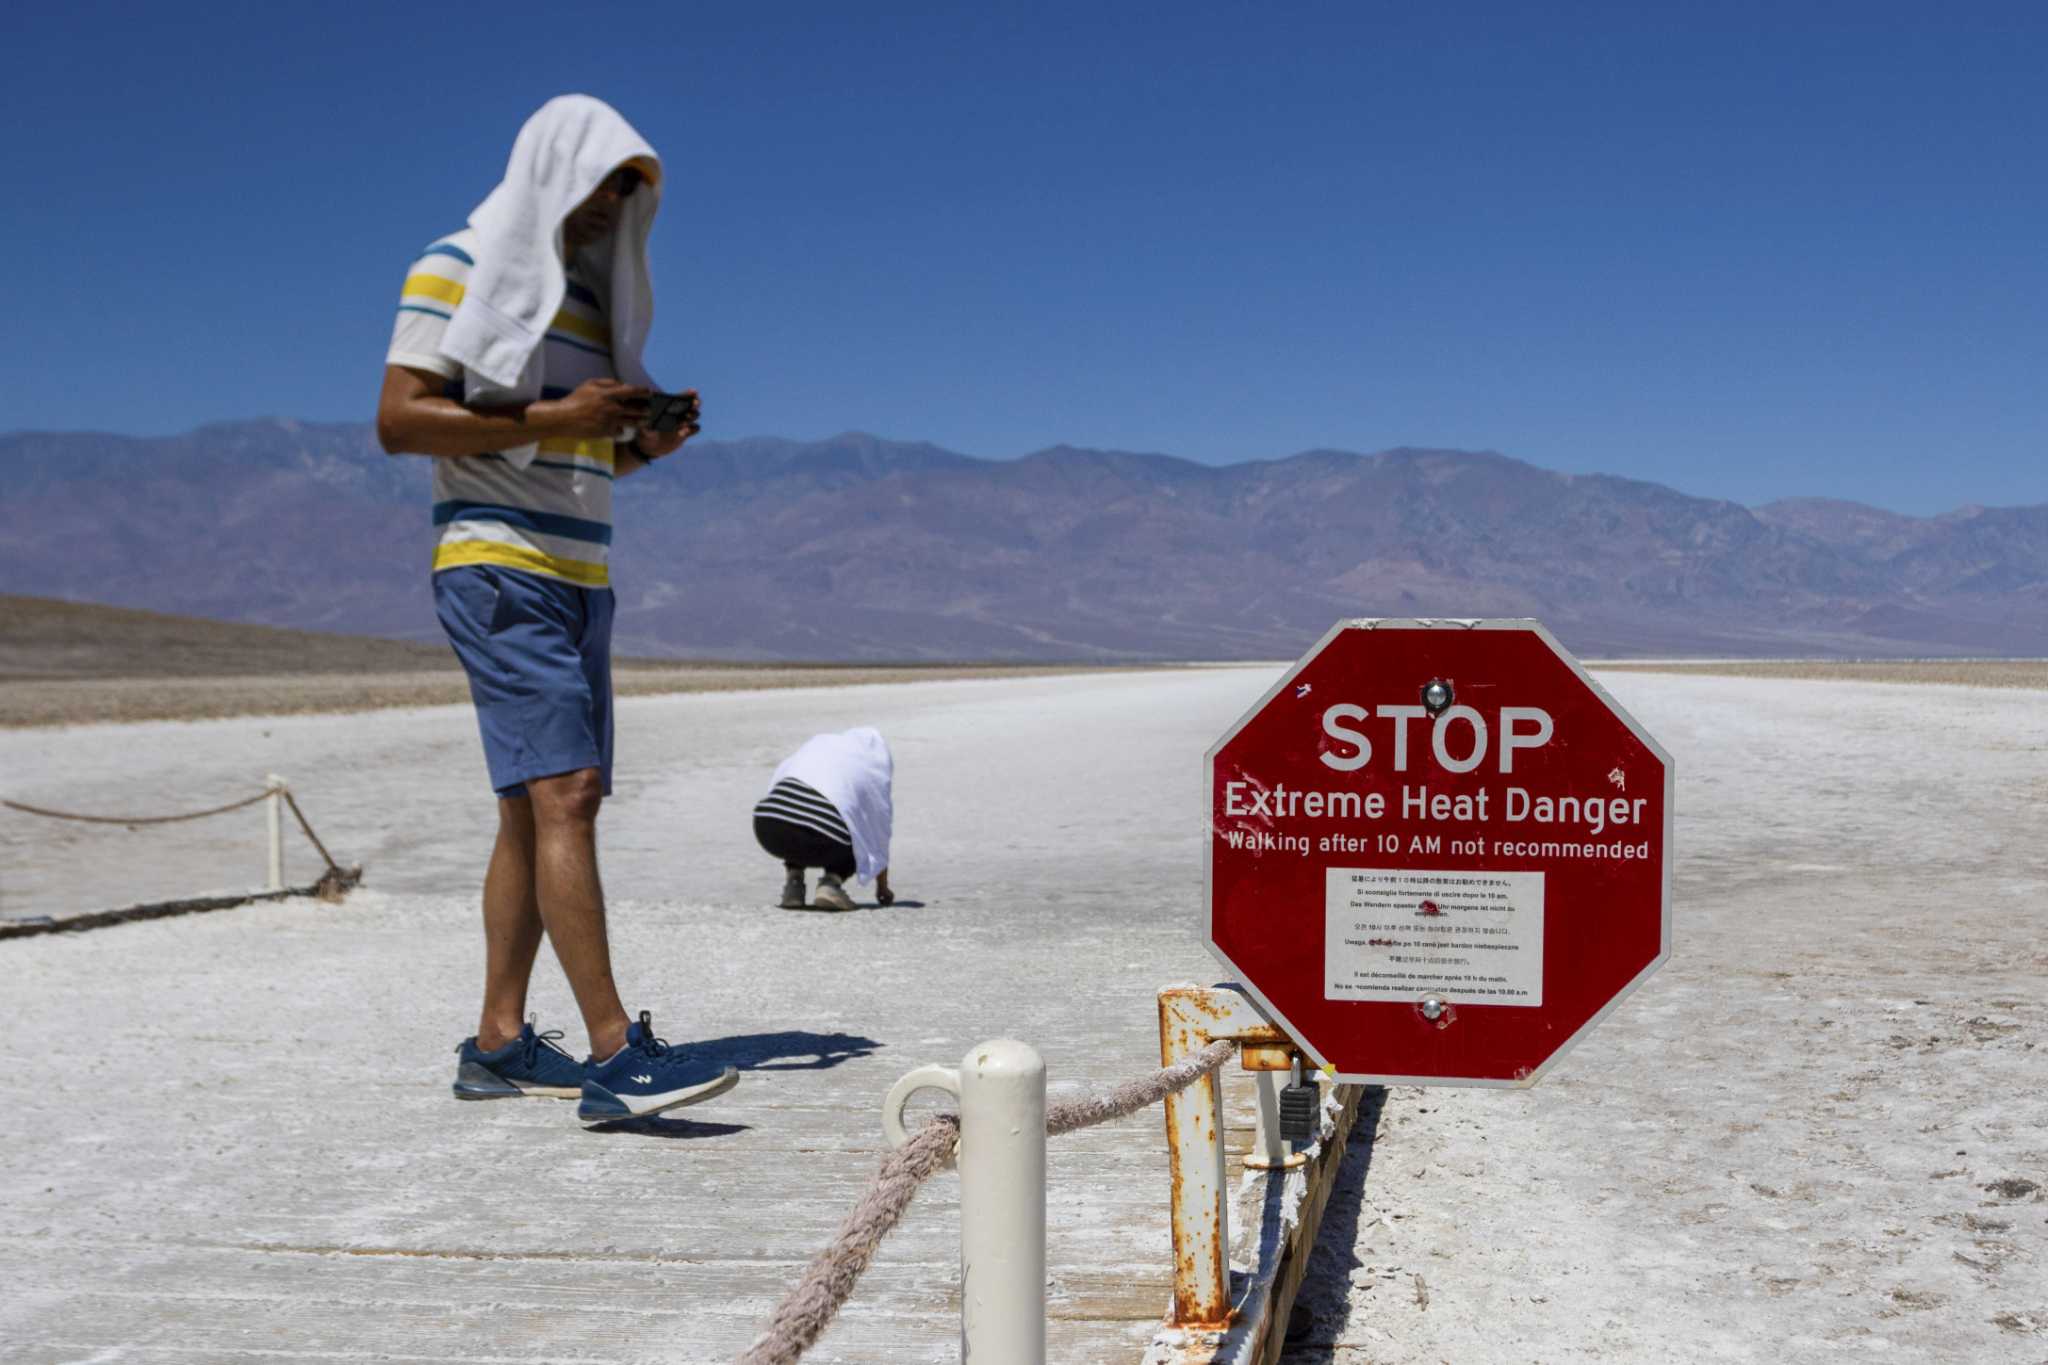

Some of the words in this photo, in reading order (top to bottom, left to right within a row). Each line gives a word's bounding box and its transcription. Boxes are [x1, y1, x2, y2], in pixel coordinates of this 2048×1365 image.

[1319, 703, 1555, 774] STOP
[1225, 781, 1385, 819] Extreme
[1402, 785, 1489, 822] Heat
[1506, 787, 1648, 835] Danger
[1228, 831, 1310, 857] Walking
[1319, 833, 1368, 854] after
[1377, 834, 1400, 854] 10
[1409, 835, 1441, 855] AM
[1451, 837, 1485, 857] not
[1494, 839, 1649, 860] recommended
[1365, 889, 1397, 897] sconsiglia
[1462, 892, 1479, 900] dopo
[1449, 986, 1476, 995] después
